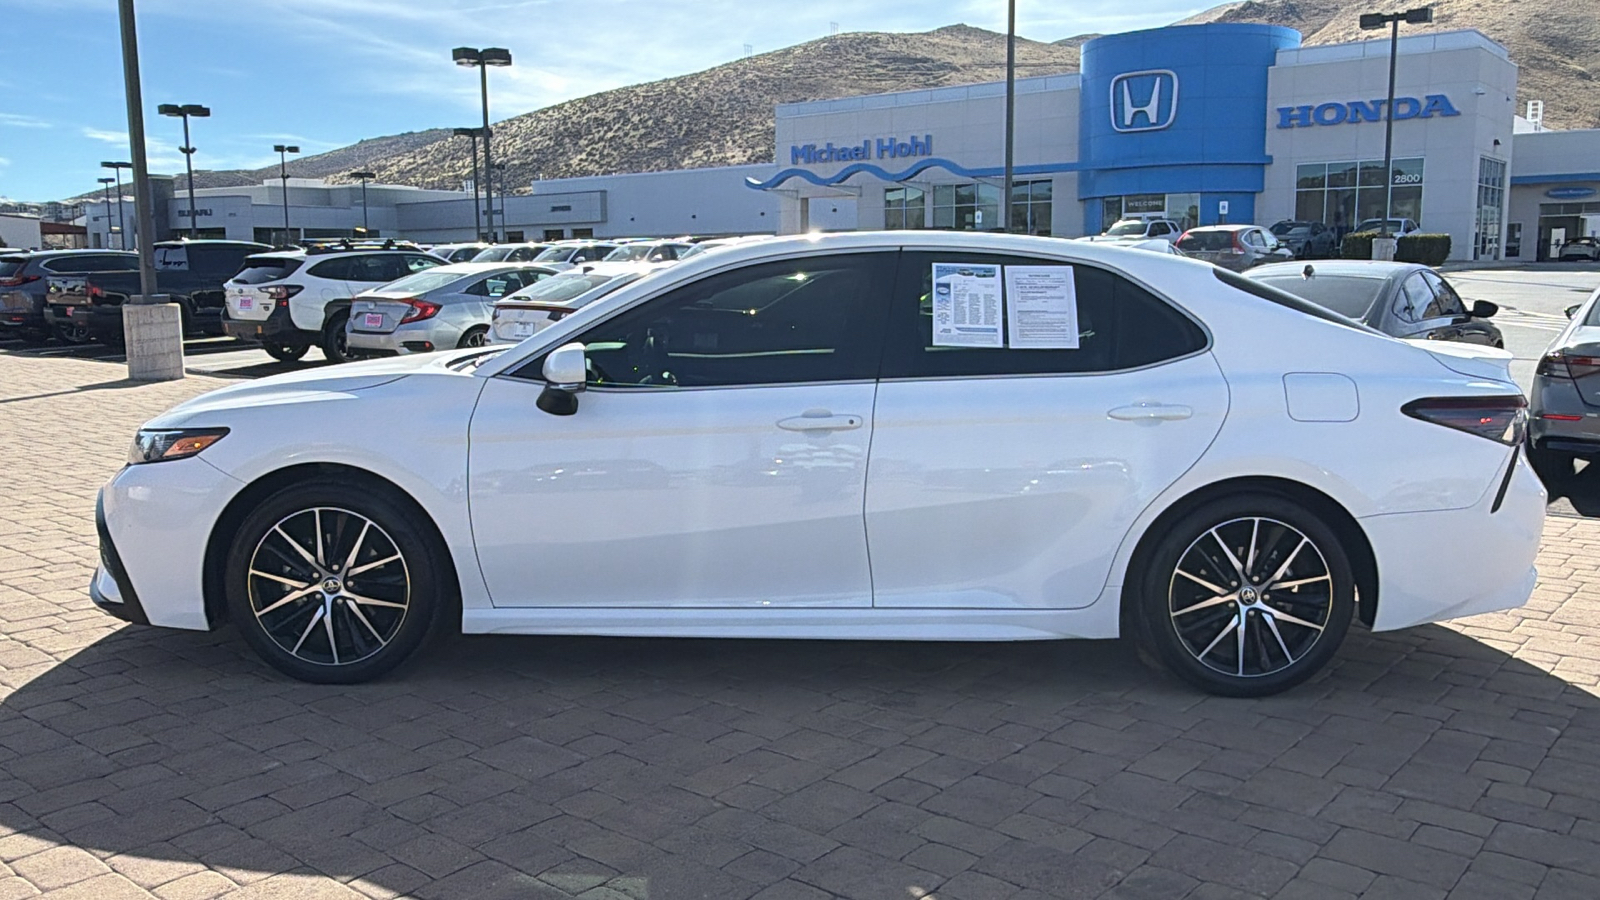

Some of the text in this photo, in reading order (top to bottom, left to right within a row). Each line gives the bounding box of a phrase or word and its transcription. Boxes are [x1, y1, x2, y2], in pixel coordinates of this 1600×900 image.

[1276, 94, 1461, 129] HONDA
[790, 134, 933, 165] Michael Hohl
[1394, 173, 1421, 184] 2800
[177, 208, 213, 217] SUARU
